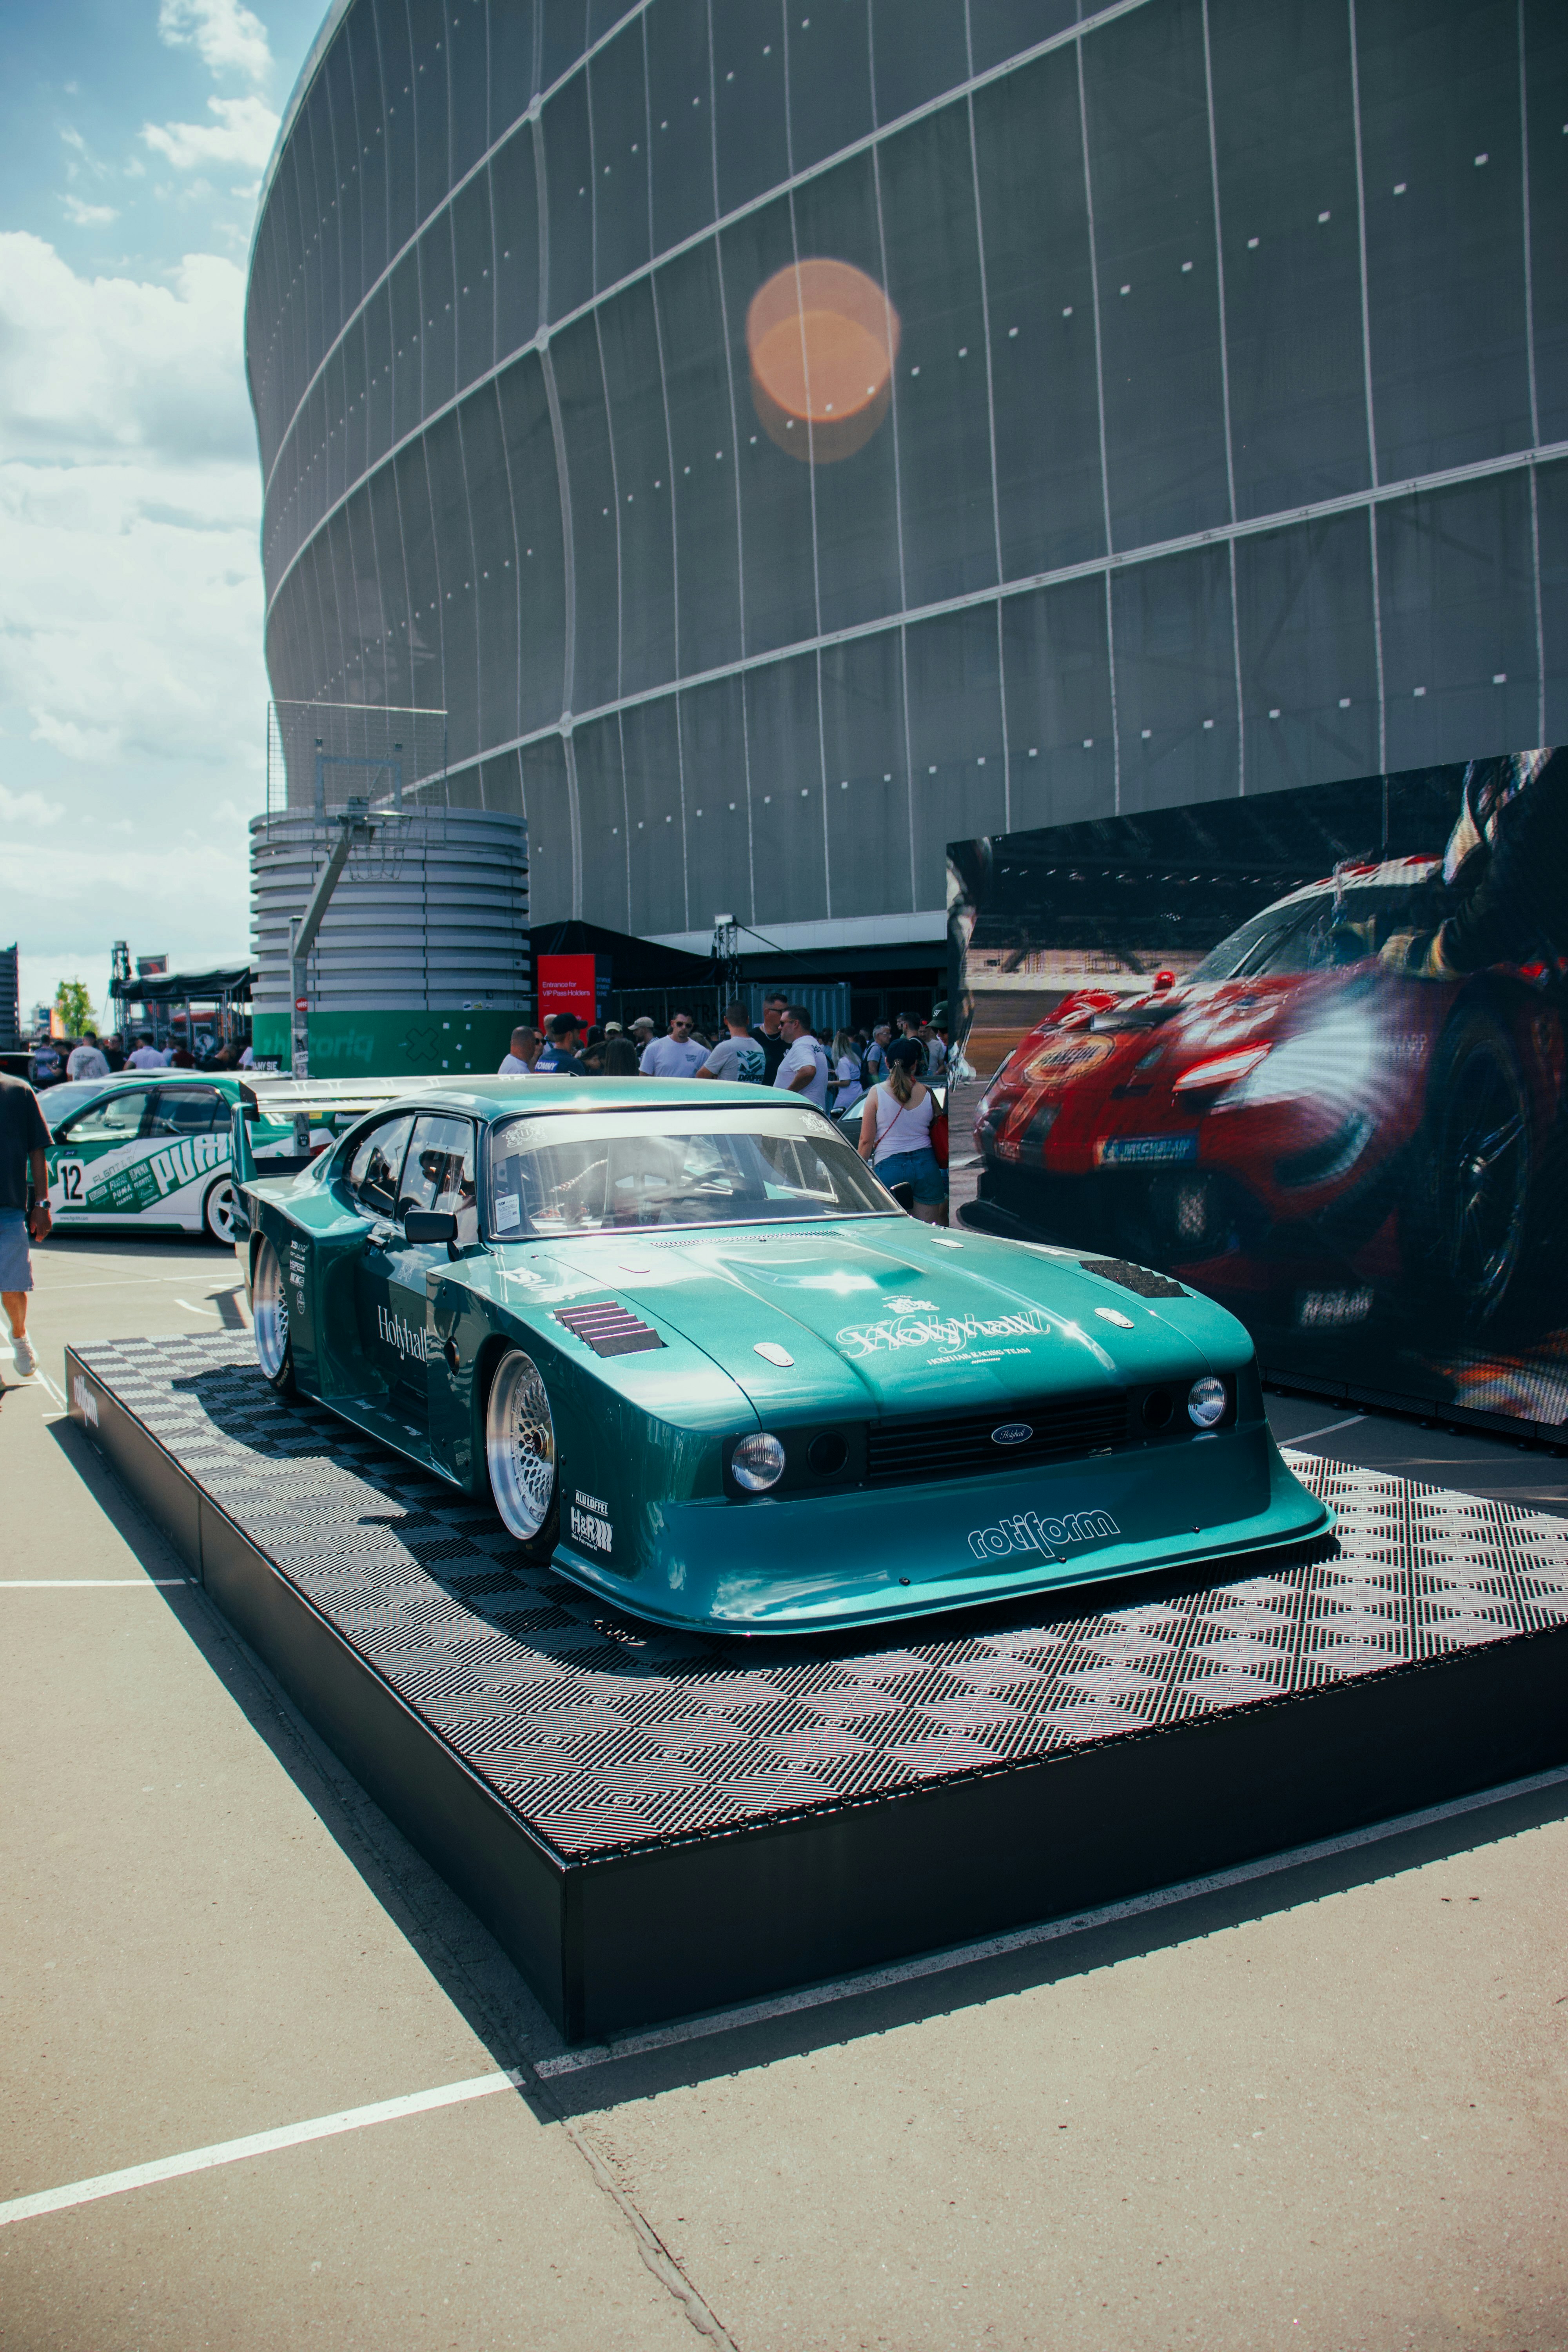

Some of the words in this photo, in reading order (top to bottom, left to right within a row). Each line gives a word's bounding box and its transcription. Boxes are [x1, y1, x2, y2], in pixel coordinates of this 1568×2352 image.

[535, 1062, 557, 1071] TOMMY
[149, 1132, 232, 1195] PUM
[60, 1165, 83, 1200] 12
[377, 1305, 427, 1363] Holyhall
[970, 1349, 1005, 1359] RACING
[1000, 1428, 1025, 1441] Holyhall
[575, 1492, 586, 1505] ALU
[587, 1497, 608, 1515] LÖFFEL
[571, 1506, 598, 1545] H&R
[968, 1510, 1121, 1559] rotiform
[579, 1537, 597, 1551] Fahrwerk!
